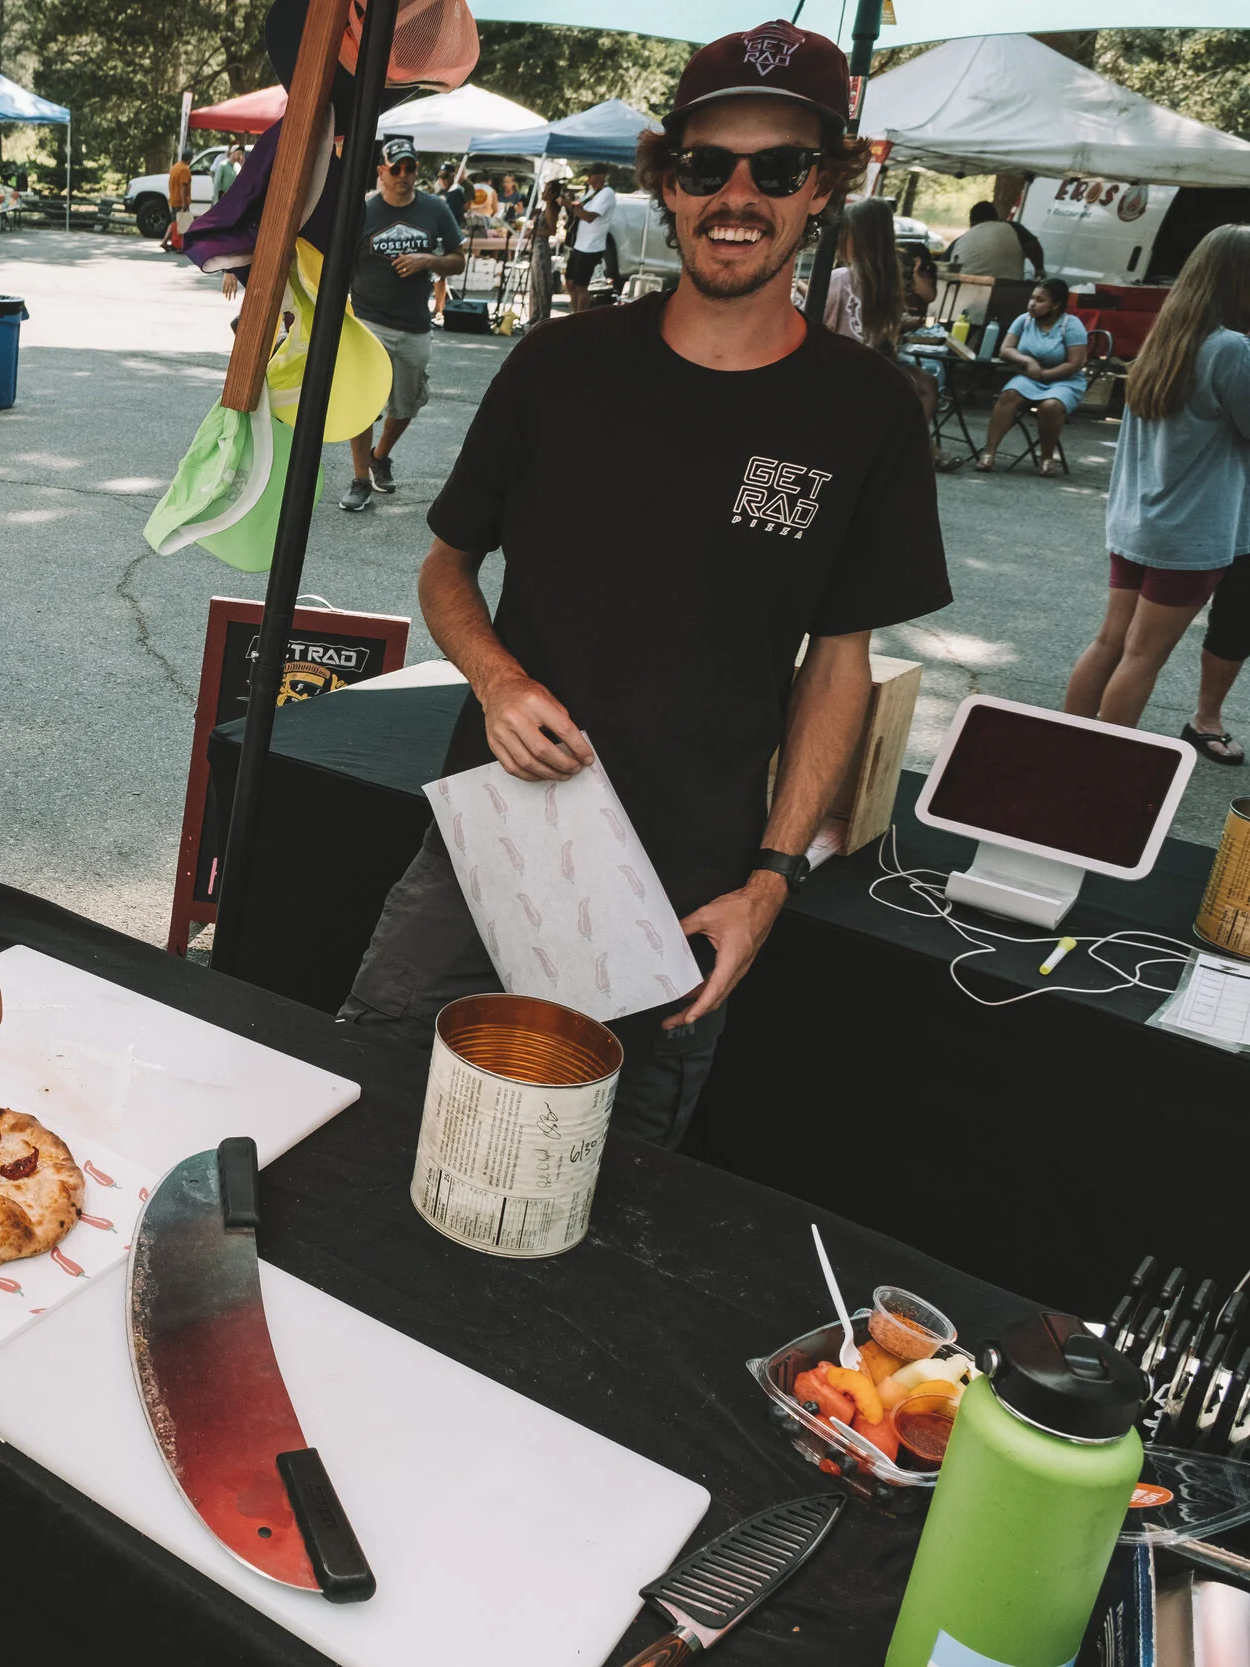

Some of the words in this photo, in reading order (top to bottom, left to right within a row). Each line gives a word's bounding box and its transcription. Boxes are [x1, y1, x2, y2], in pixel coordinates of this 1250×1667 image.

[747, 39, 791, 54] GET
[743, 51, 790, 67] RAD
[373, 240, 429, 250] YOSEMITE
[743, 455, 833, 500] GET
[733, 485, 819, 529] RAD
[731, 515, 803, 539] PIZZA
[307, 646, 357, 667] RAD
[570, 1140, 598, 1163] 6/30
